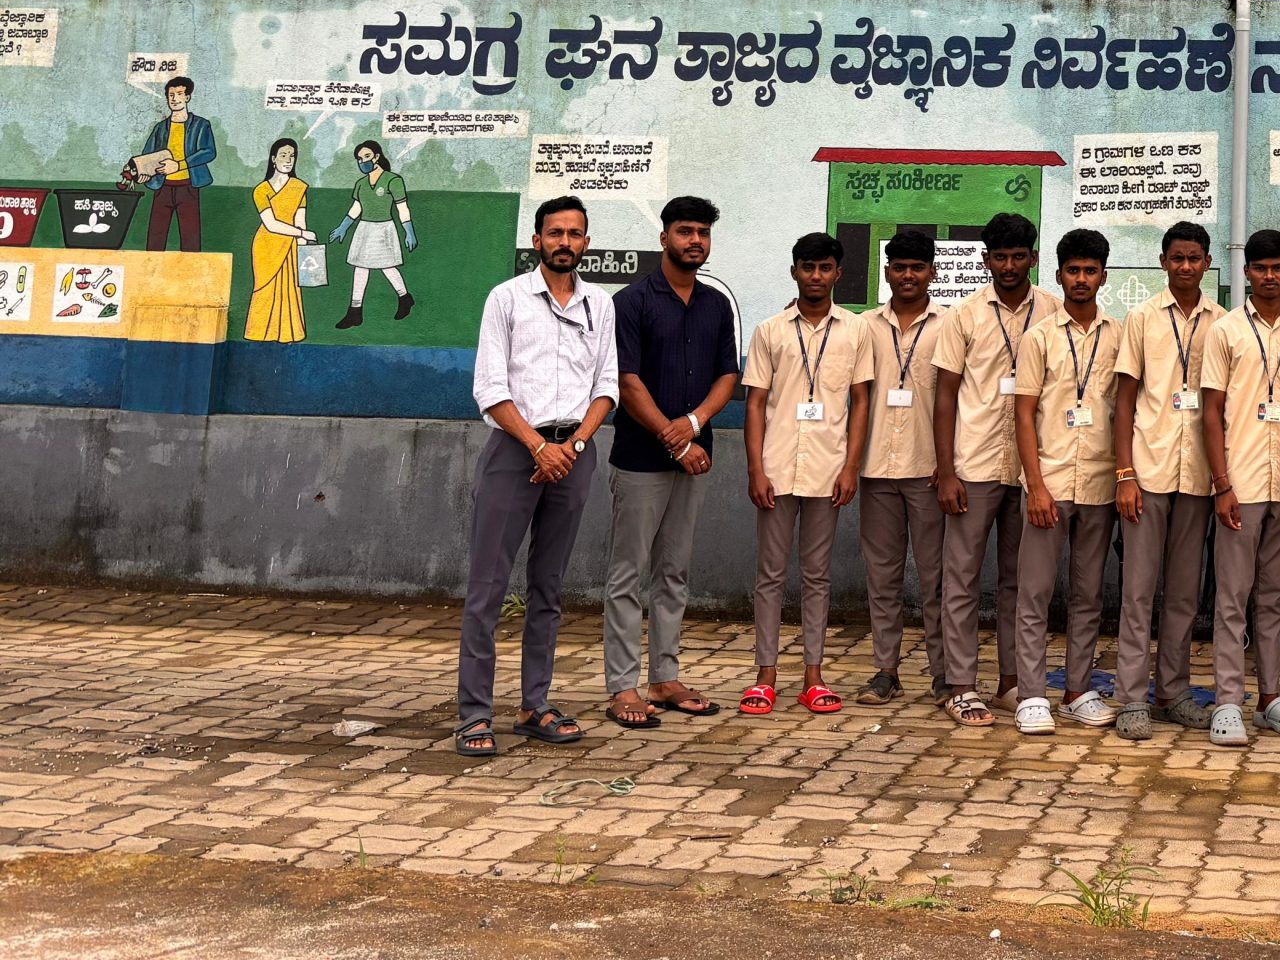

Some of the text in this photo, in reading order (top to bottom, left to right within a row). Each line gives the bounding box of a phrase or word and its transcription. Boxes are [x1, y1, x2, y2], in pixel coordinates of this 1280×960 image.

[132, 58, 176, 71] ಹೌದು ನಿಜ
[359, 12, 522, 96] ಸಮಗ್ರ
[546, 15, 662, 90] ಘನ
[675, 21, 822, 107] ತ್ಯಾಜ್ಯದ
[831, 18, 1015, 112] ವೈಜ್ಞಾನಿಕ
[1022, 20, 1235, 92] ನಿರ್ವಹಣೆ
[350, 96, 372, 108] ಕಸ
[1150, 146, 1173, 156] ಒಣ
[1178, 145, 1201, 155] ಕಸ
[534, 160, 565, 178] ಮತ್ತು
[1080, 168, 1096, 178] ಈ
[1173, 164, 1201, 177] ನಾವು
[570, 177, 628, 189] ನೀಡಬೇಕು
[1122, 180, 1144, 193] ಹೀಗೆ
[75, 199, 90, 210] ಹಸಿ
